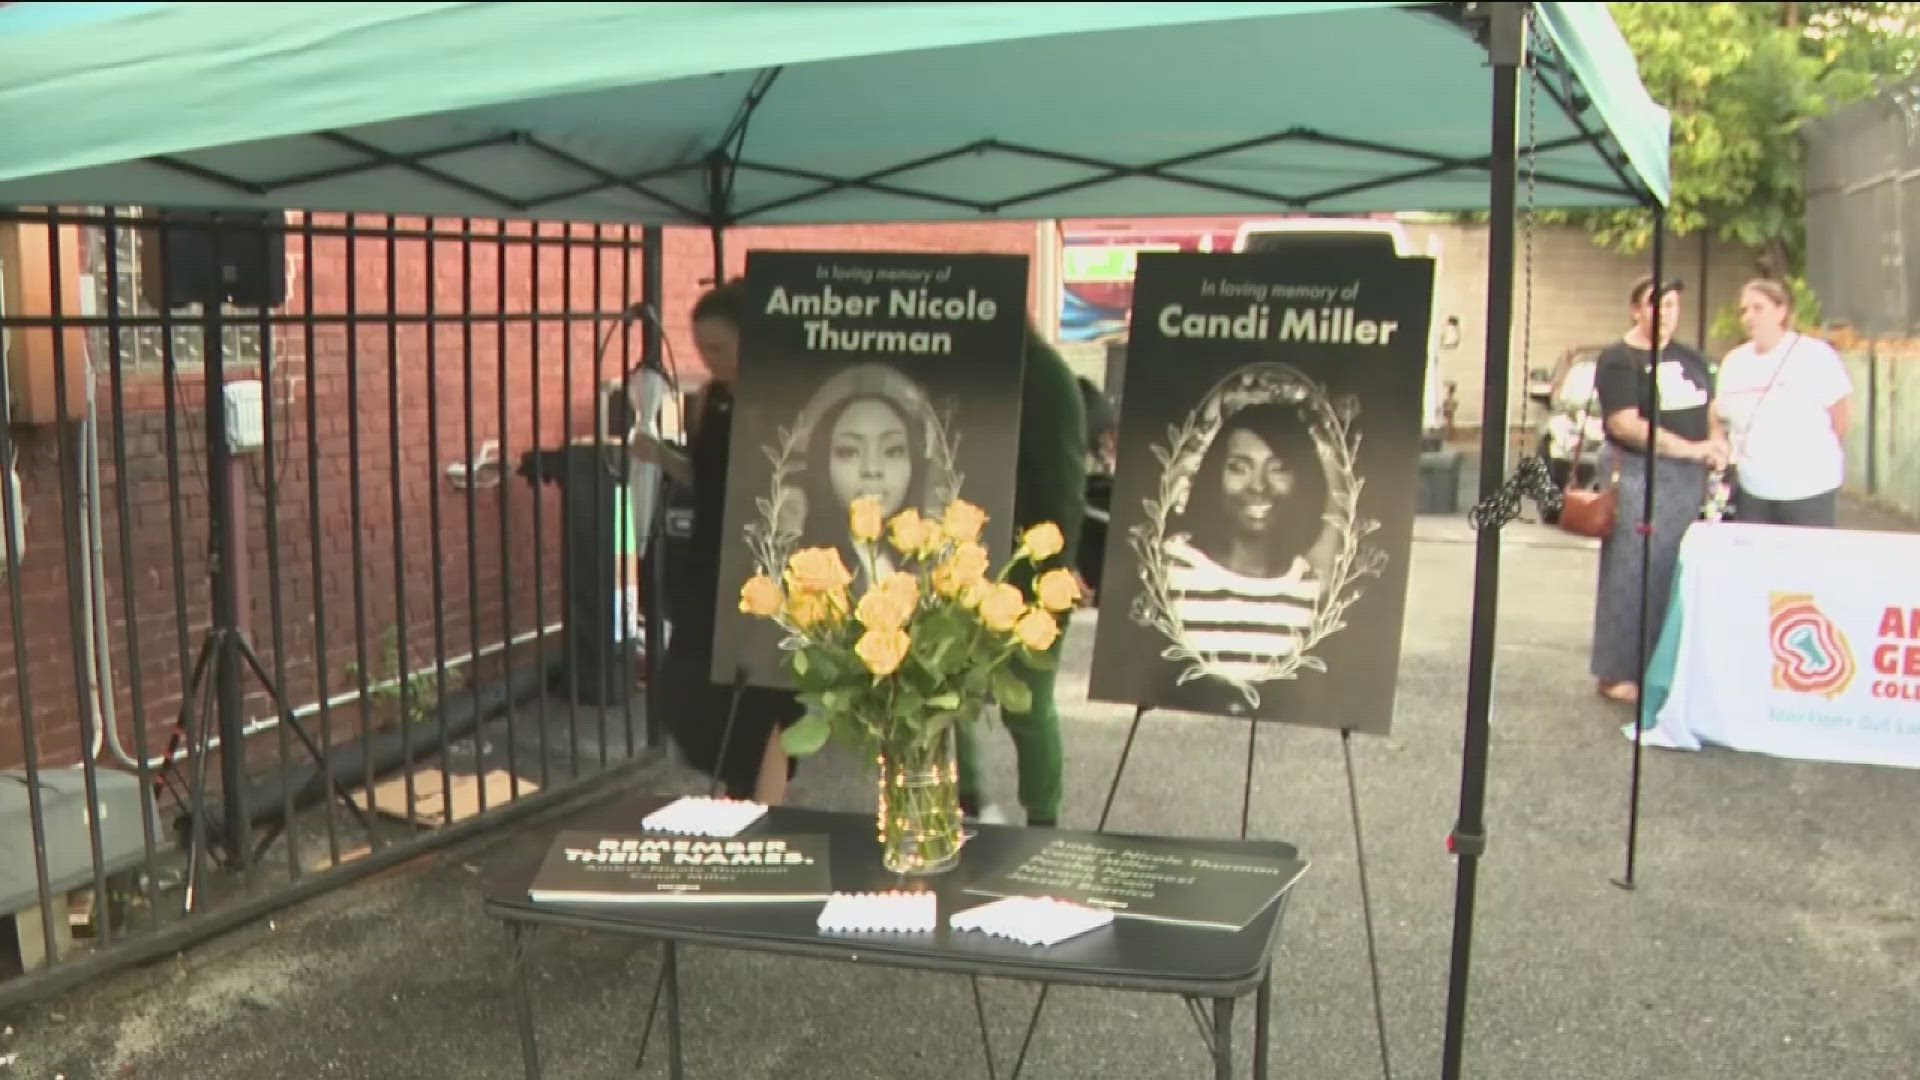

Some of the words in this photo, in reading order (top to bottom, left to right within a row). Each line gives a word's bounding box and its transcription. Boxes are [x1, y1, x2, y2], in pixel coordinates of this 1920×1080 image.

[815, 265, 829, 279] In
[832, 264, 873, 285] loving
[1201, 278, 1216, 297] In
[1219, 277, 1268, 302] loving
[1271, 283, 1338, 302] memory
[1341, 279, 1360, 300] of
[765, 284, 880, 316] Amber
[889, 287, 998, 321] Nicole
[803, 319, 952, 354] Thurman
[1158, 302, 1270, 339] Candi
[1278, 306, 1399, 346] Miller
[564, 848, 661, 864] THEIR
[674, 851, 815, 866] NAMES.
[598, 838, 787, 854] REMEMBER
